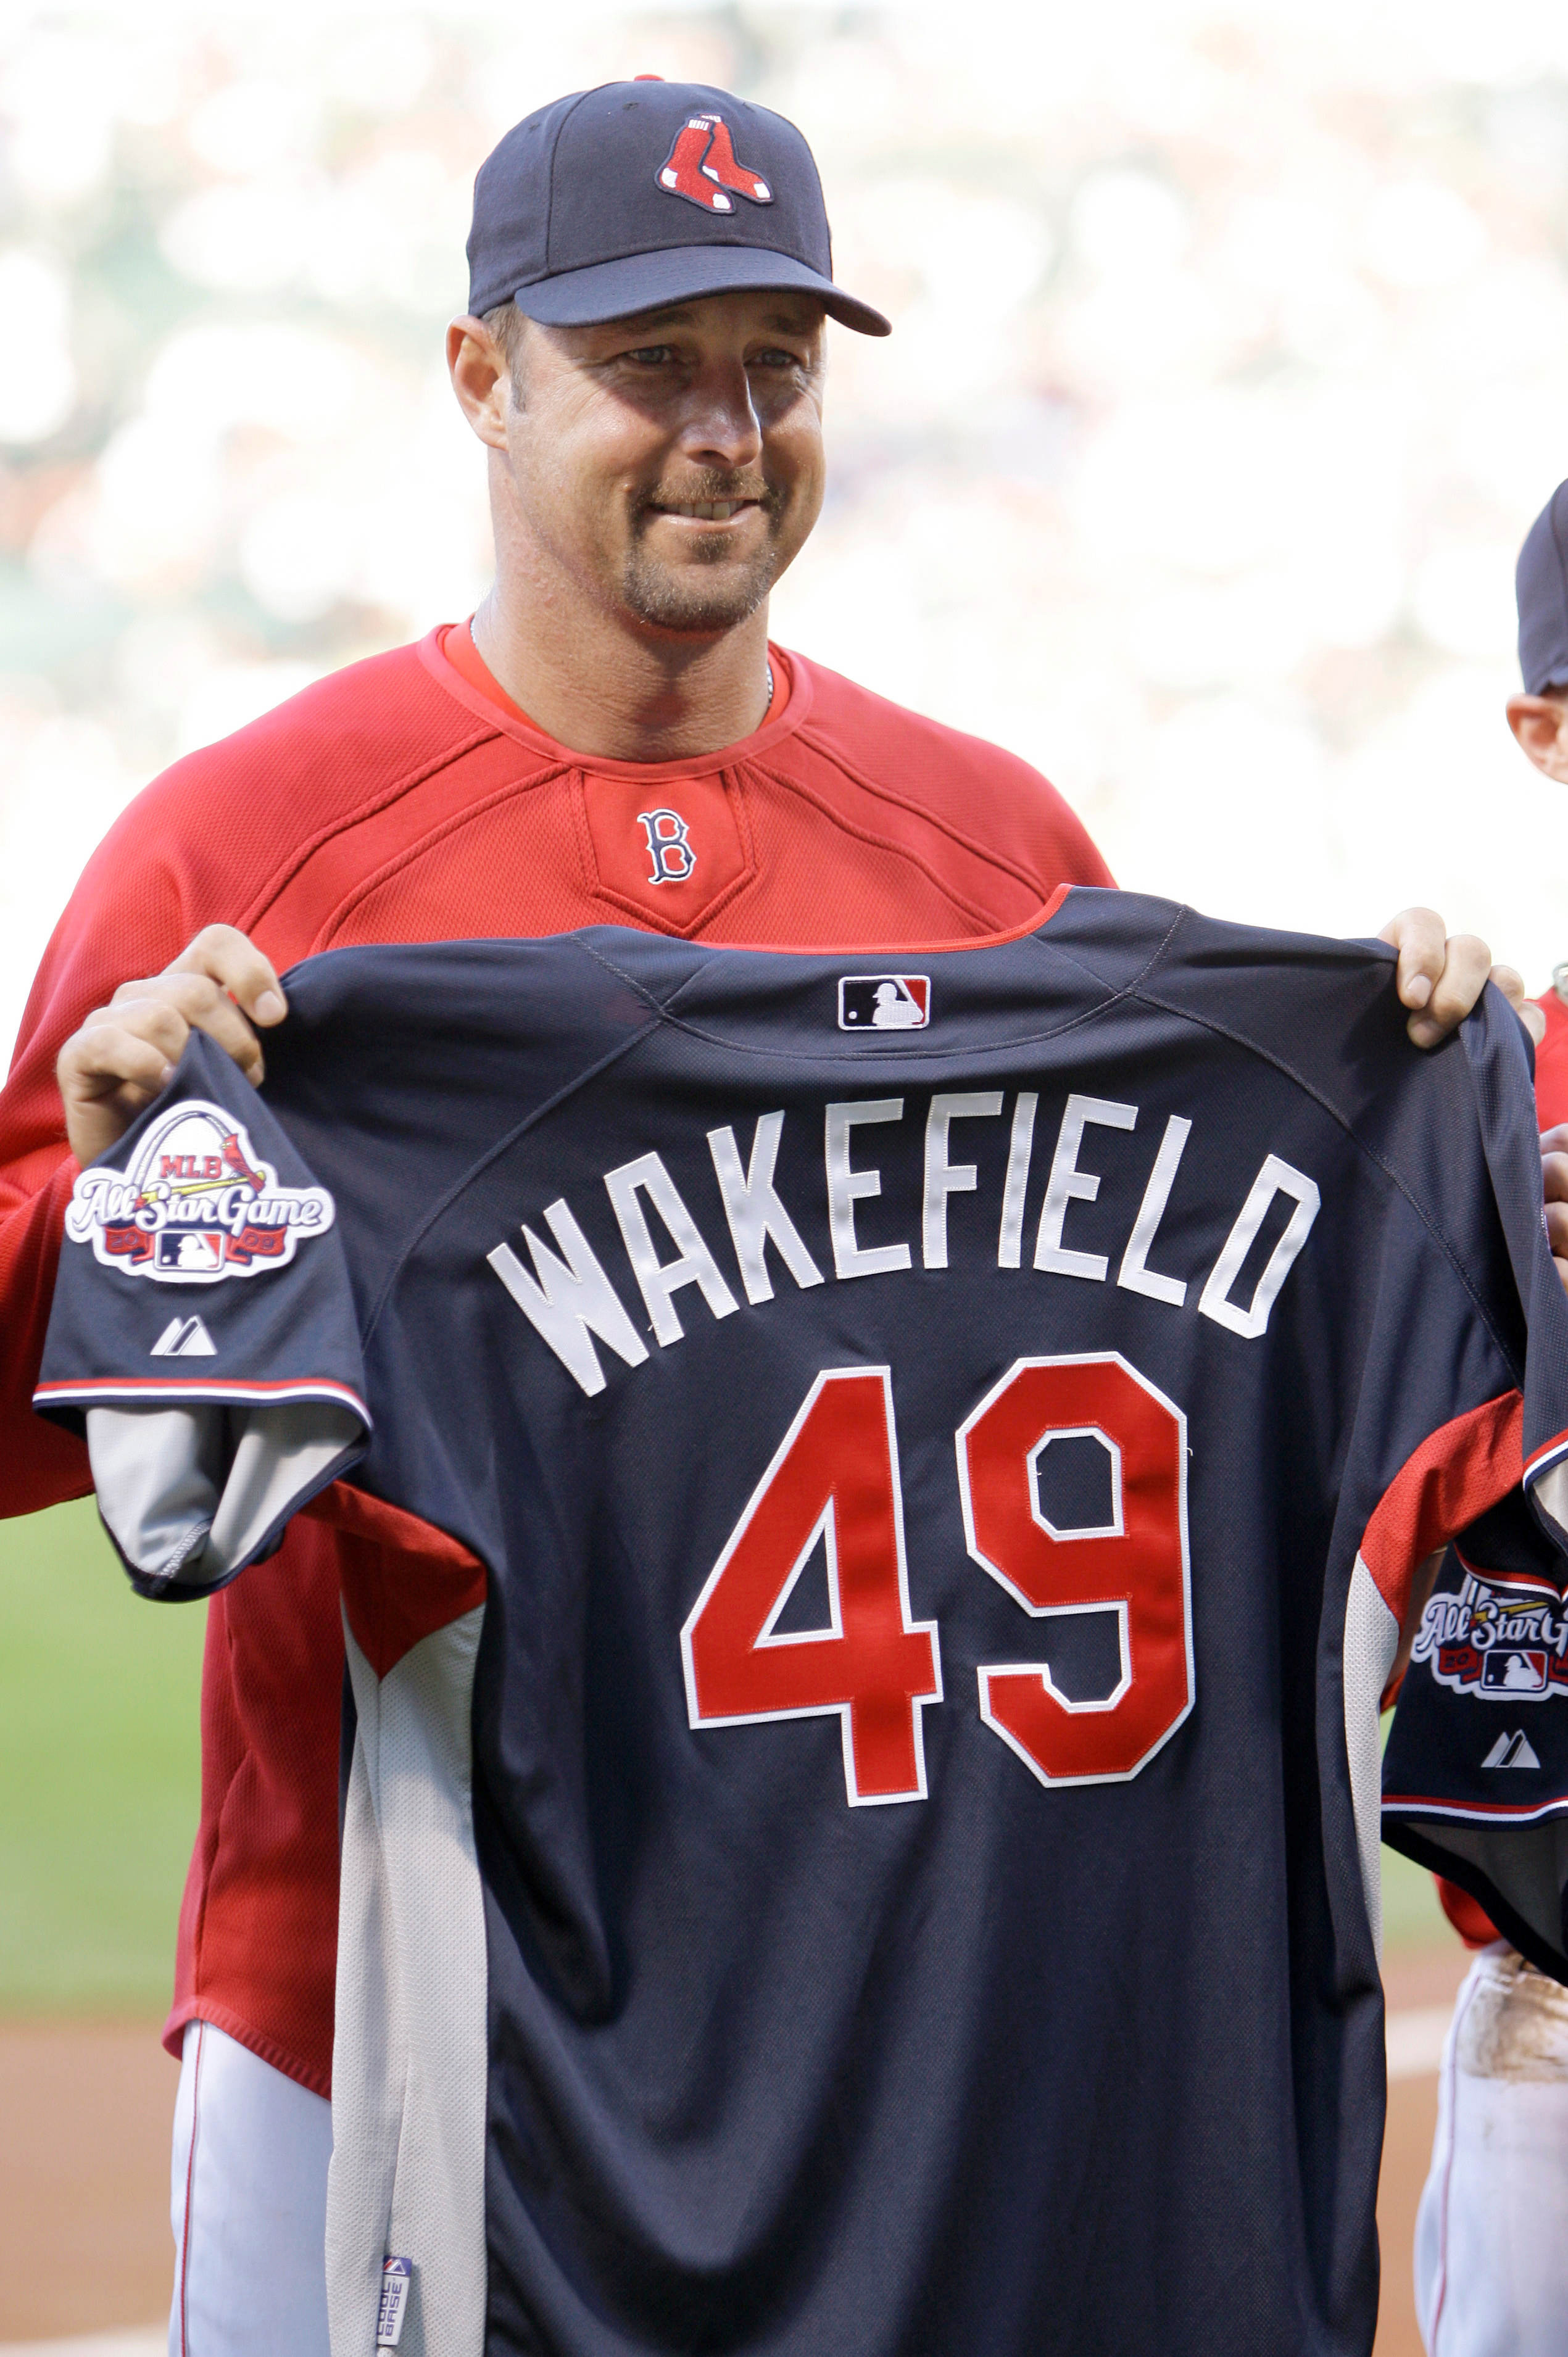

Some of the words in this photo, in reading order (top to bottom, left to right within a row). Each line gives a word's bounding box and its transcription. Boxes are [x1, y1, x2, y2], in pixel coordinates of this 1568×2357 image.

[637, 809, 697, 885] B
[161, 1155, 222, 1179] MLB
[72, 1178, 139, 1232] All
[136, 1181, 218, 1232] Star
[218, 1184, 322, 1237] Game
[486, 1091, 1321, 1398] WAKEFIELD
[679, 1351, 1195, 1808] 49
[1416, 1602, 1472, 1650] All
[1471, 1602, 1540, 1651] Star
[385, 2283, 402, 2337] BASE
